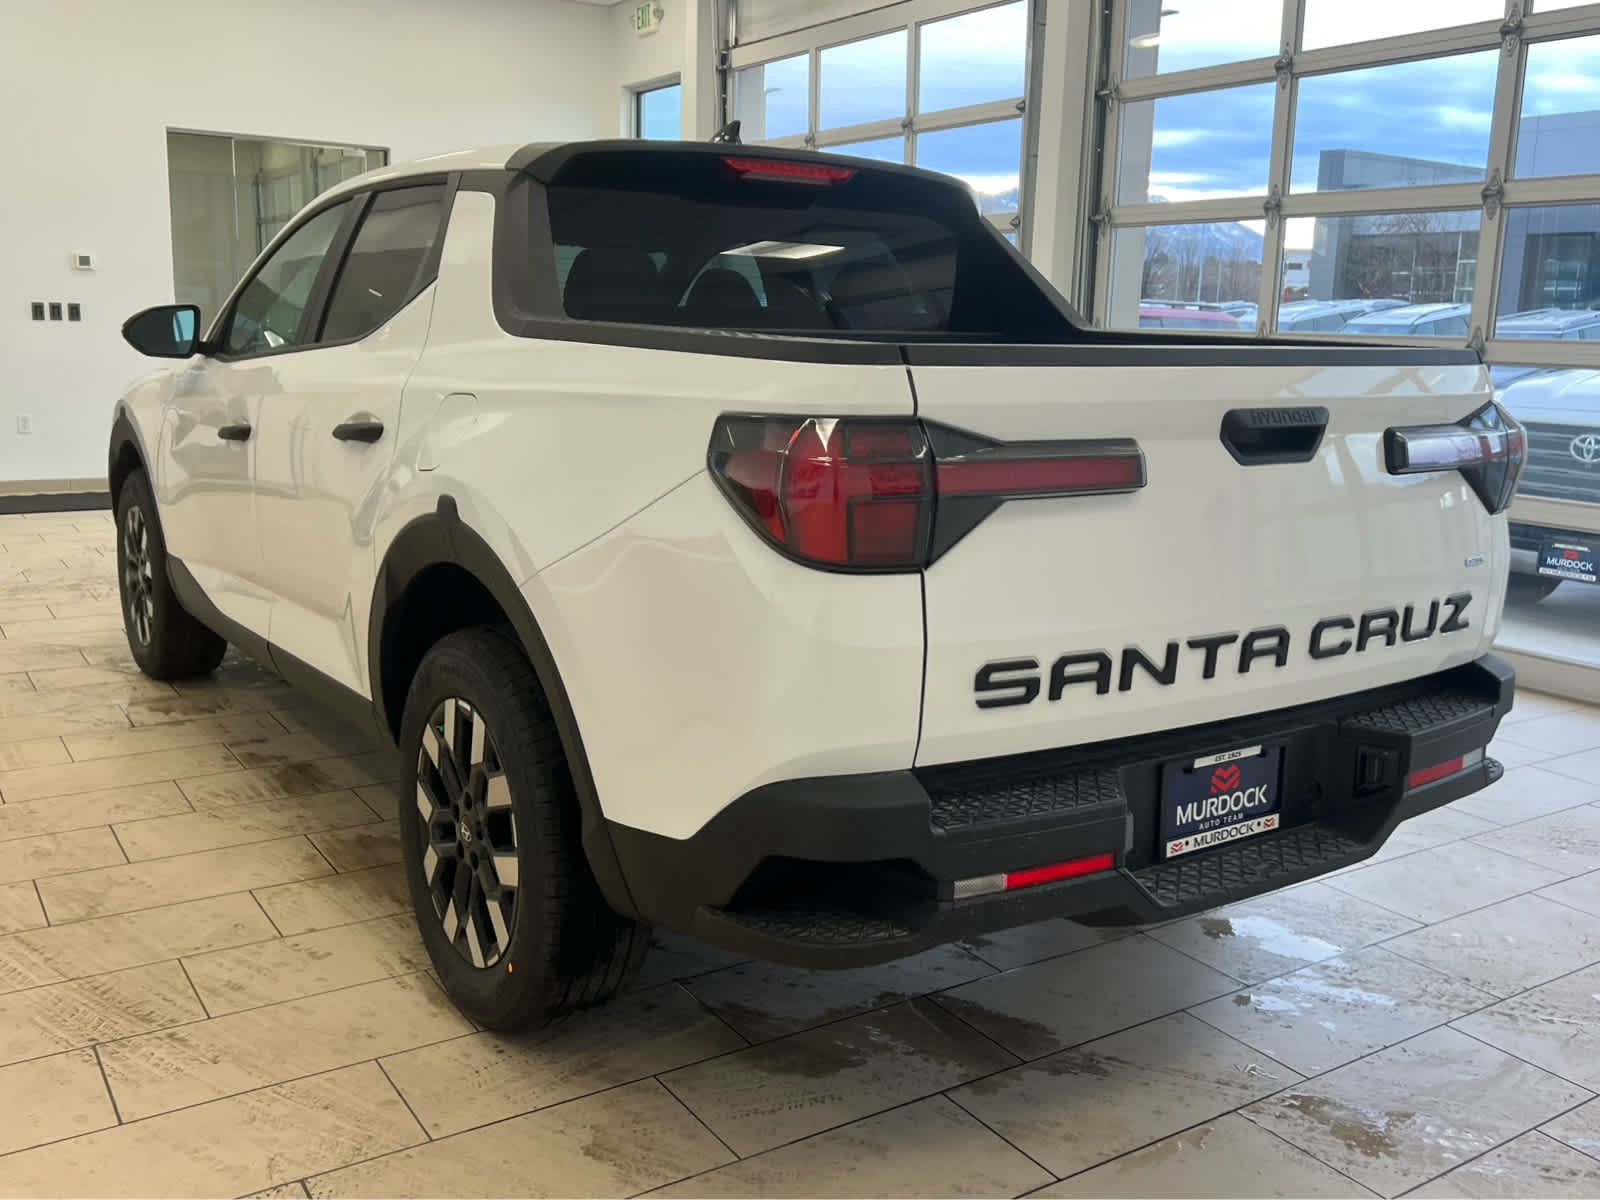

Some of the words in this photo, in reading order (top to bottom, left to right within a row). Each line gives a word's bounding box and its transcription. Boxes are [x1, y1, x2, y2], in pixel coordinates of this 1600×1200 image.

[636, 3, 651, 30] EXIT
[1546, 556, 1593, 572] MURDOCK
[974, 624, 1290, 708] SANTA
[1308, 592, 1473, 660] CRUZ
[1176, 784, 1268, 826] MURDOCK
[1199, 818, 1221, 830] AUTO
[1223, 812, 1244, 824] TEAM
[1193, 822, 1255, 849] MURDOCK
